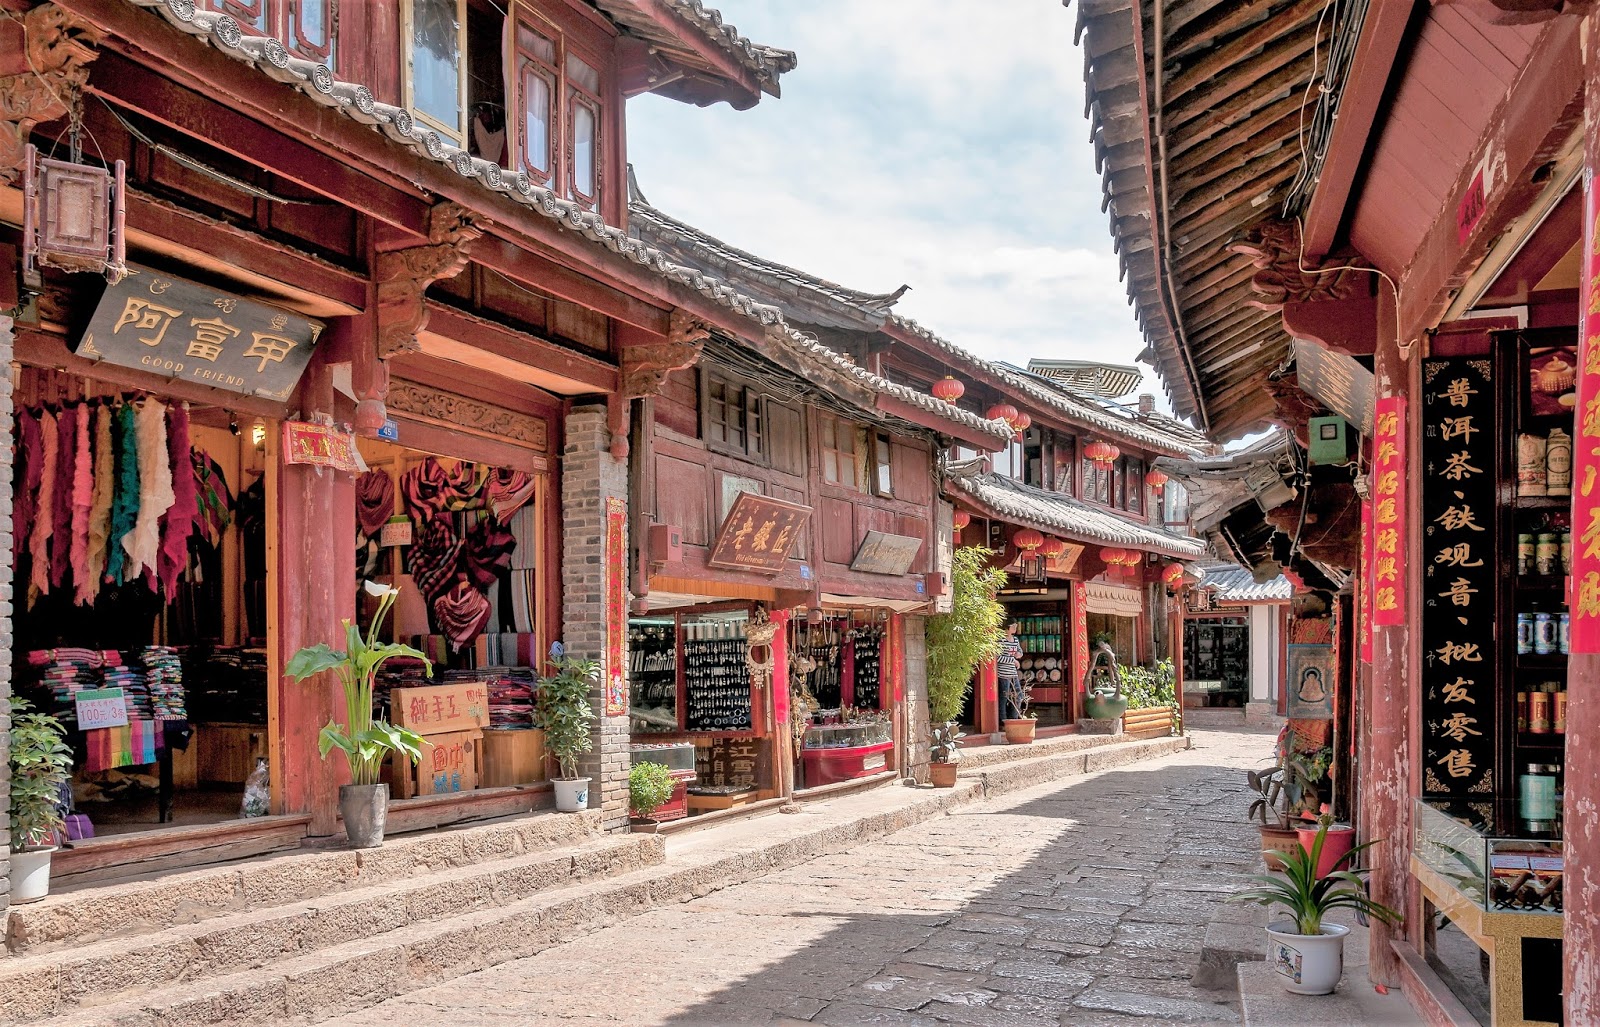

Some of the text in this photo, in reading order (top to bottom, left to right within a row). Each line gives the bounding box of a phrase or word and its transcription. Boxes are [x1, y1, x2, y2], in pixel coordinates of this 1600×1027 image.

[113, 297, 298, 373] 阿富甲
[141, 355, 245, 387] GOOD FRIEND
[383, 427, 392, 436] 45
[1434, 377, 1485, 778] 普洱茶、铁观音、批发零售
